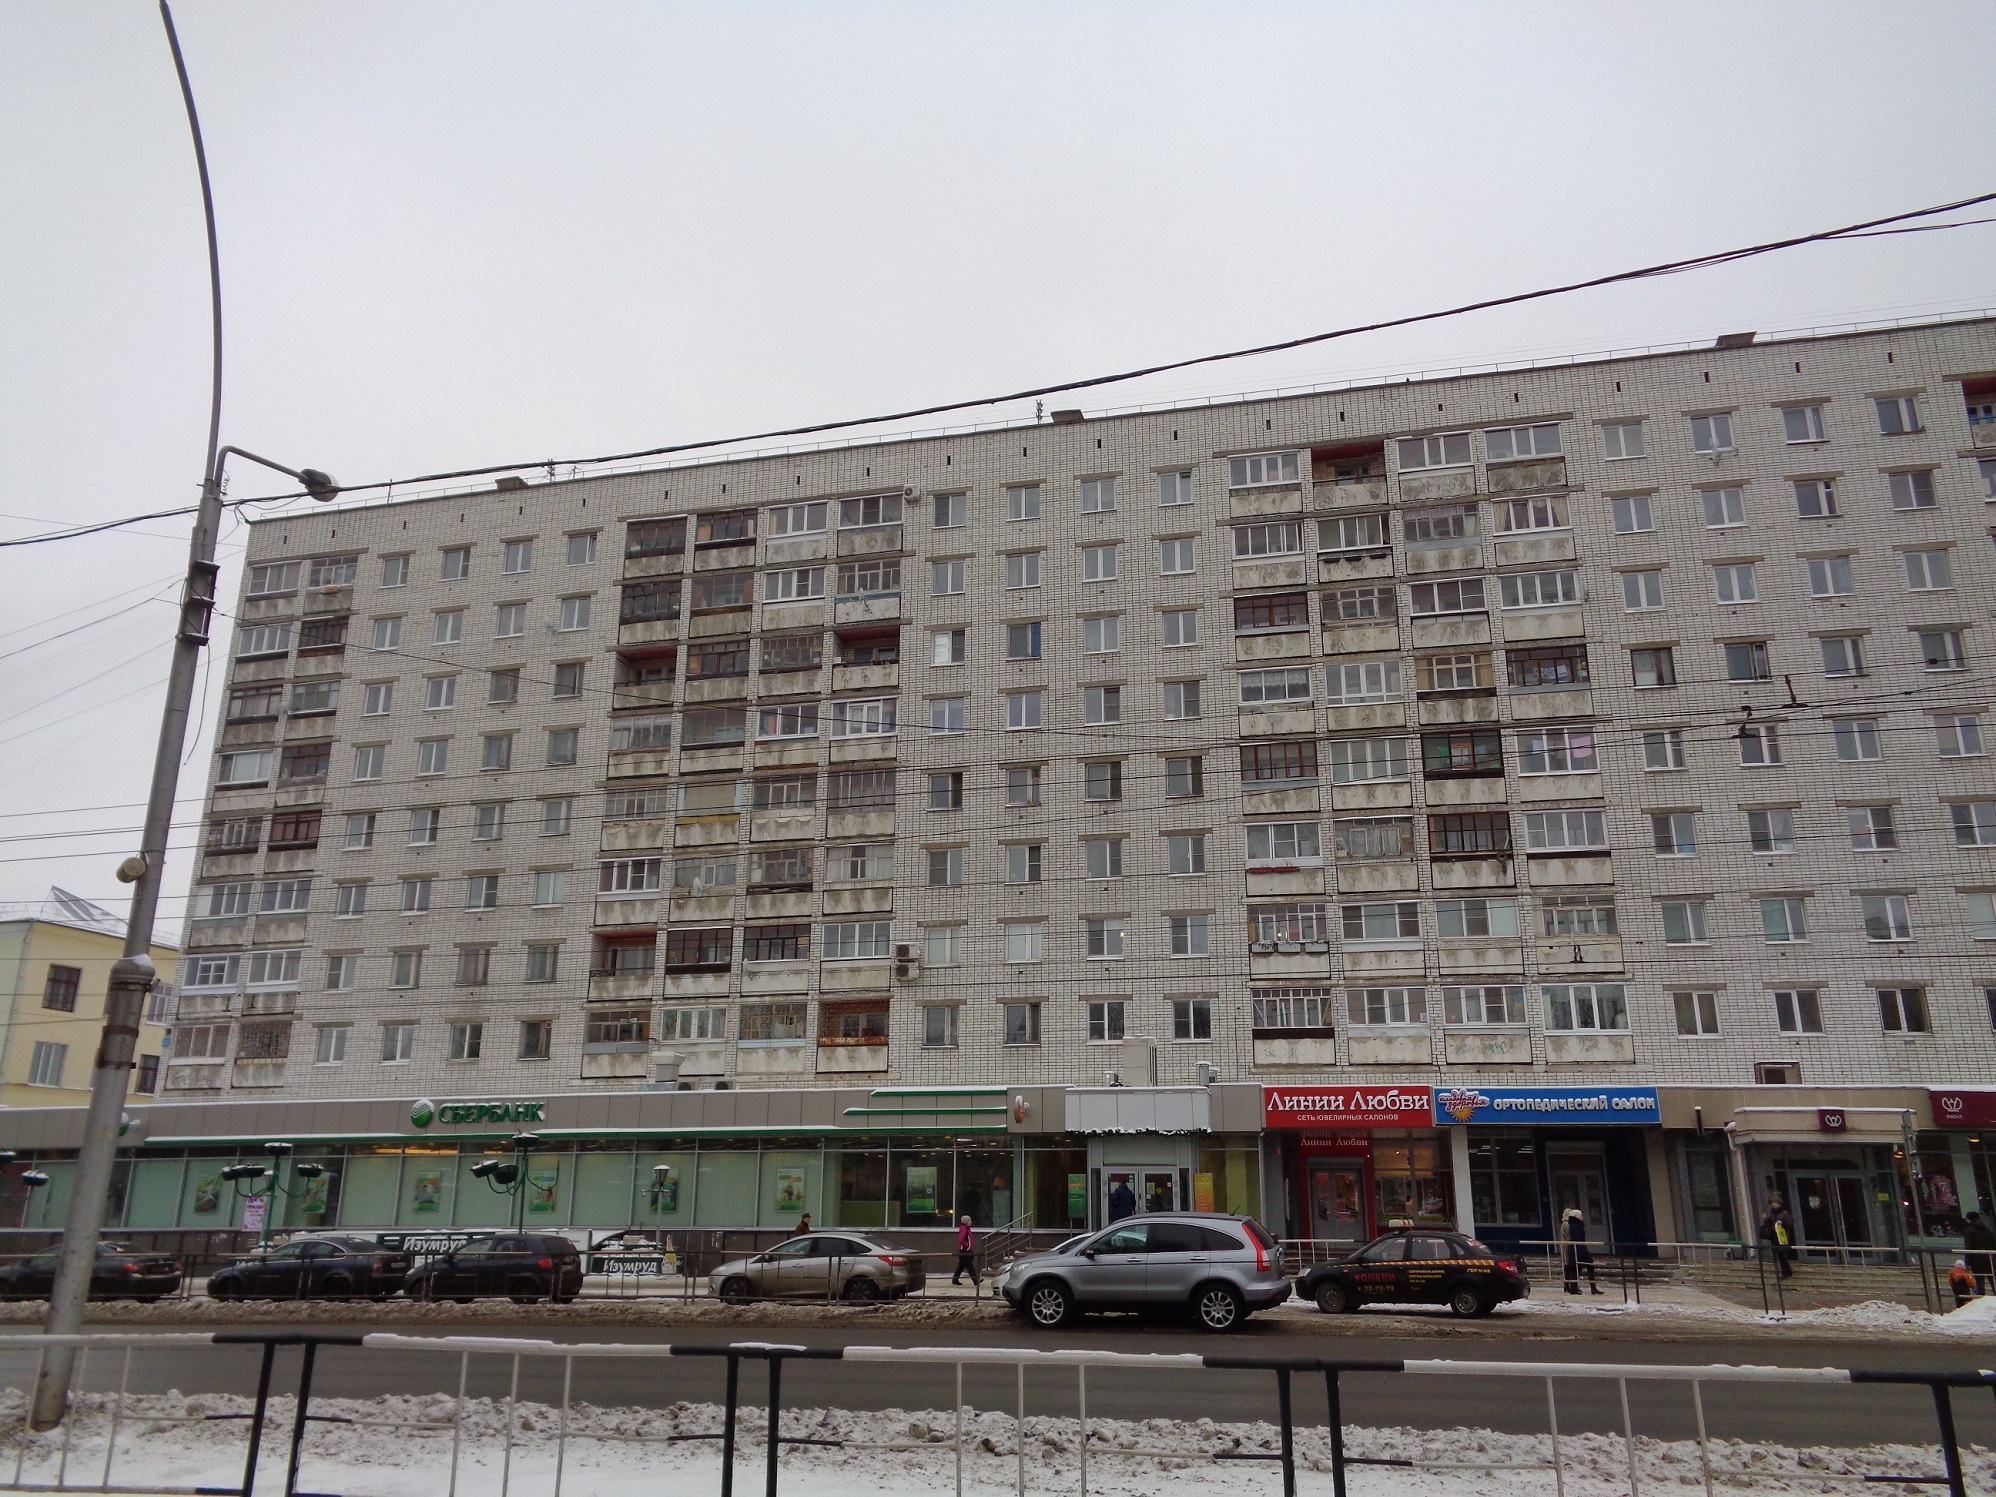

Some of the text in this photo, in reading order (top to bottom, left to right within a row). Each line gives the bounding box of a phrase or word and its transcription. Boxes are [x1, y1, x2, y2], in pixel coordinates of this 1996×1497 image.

[1267, 1090, 1429, 1111] Линии Любви
[1494, 1095, 1655, 1112] ОРТОПЕДИЧЕСКИЙ САЛОН
[438, 1102, 545, 1123] СБЕРБАНК
[1301, 1138, 1368, 1146] Линии Любви
[602, 1259, 658, 1275] Изумруд
